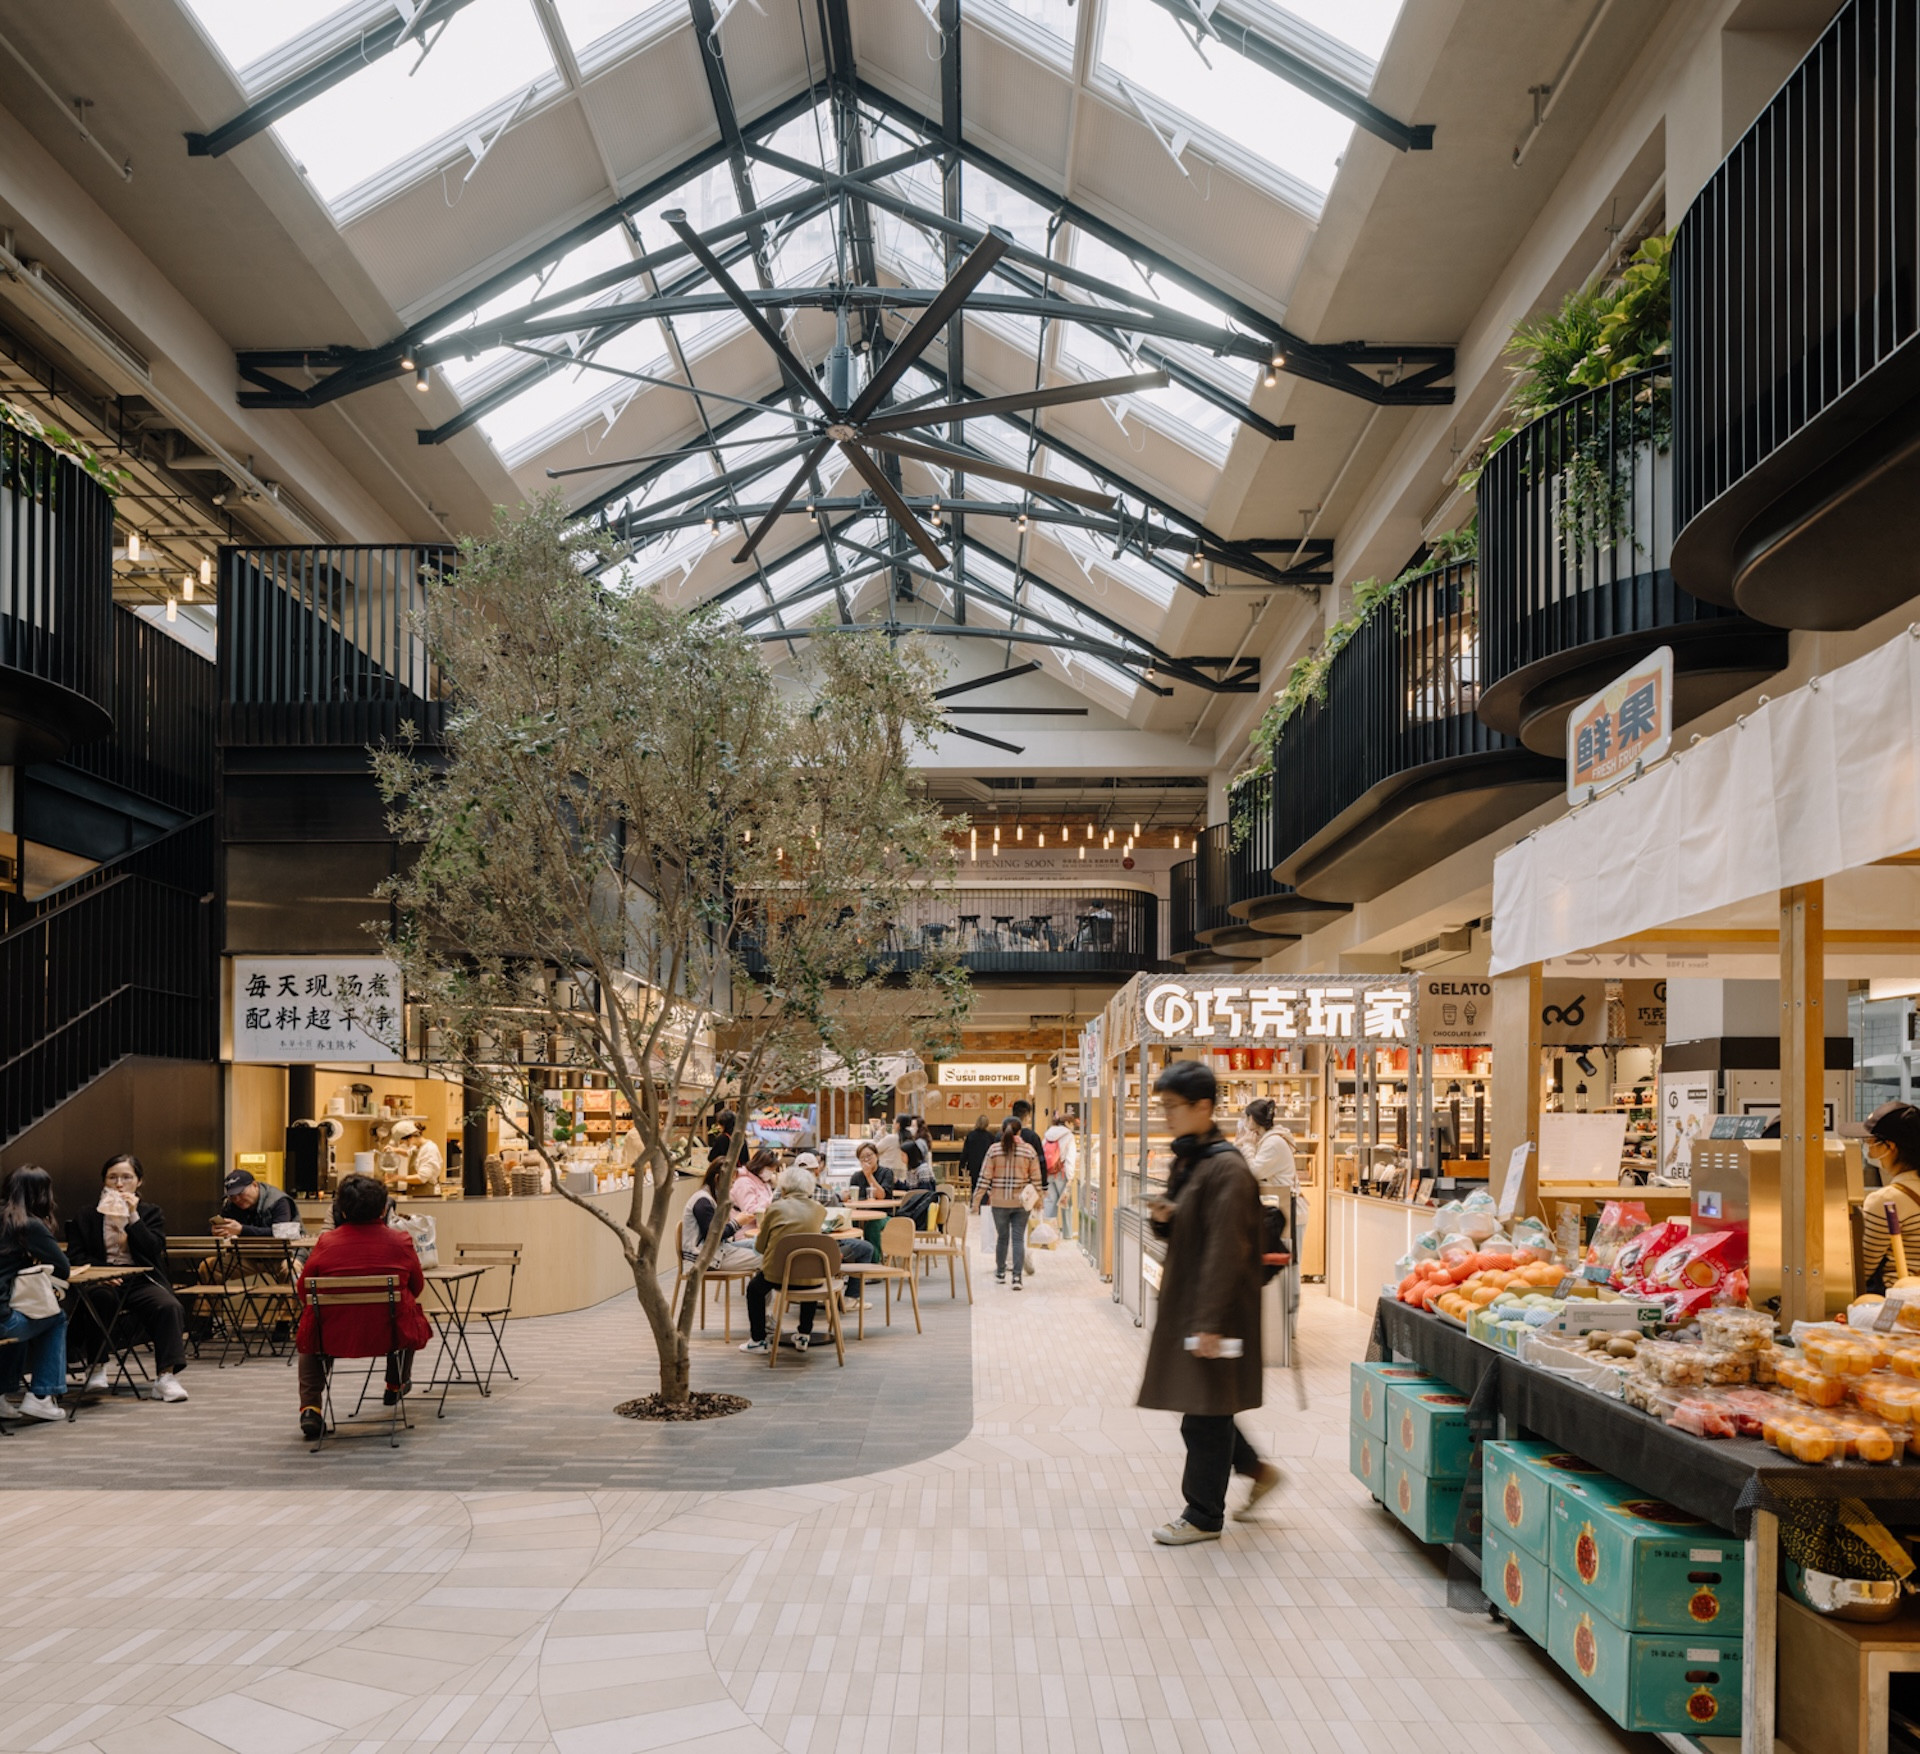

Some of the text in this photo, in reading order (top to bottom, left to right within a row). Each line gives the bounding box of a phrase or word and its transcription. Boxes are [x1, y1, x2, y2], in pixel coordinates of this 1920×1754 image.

[1577, 680, 1656, 774] 鲜果
[1592, 741, 1643, 779] FRESH FRUIT
[971, 860, 1019, 868] OPENING
[1024, 860, 1055, 868] SOON
[1429, 982, 1491, 995] GELATO
[1193, 987, 1412, 1038] 巧克玩家
[979, 1074, 1020, 1082] BROTHER
